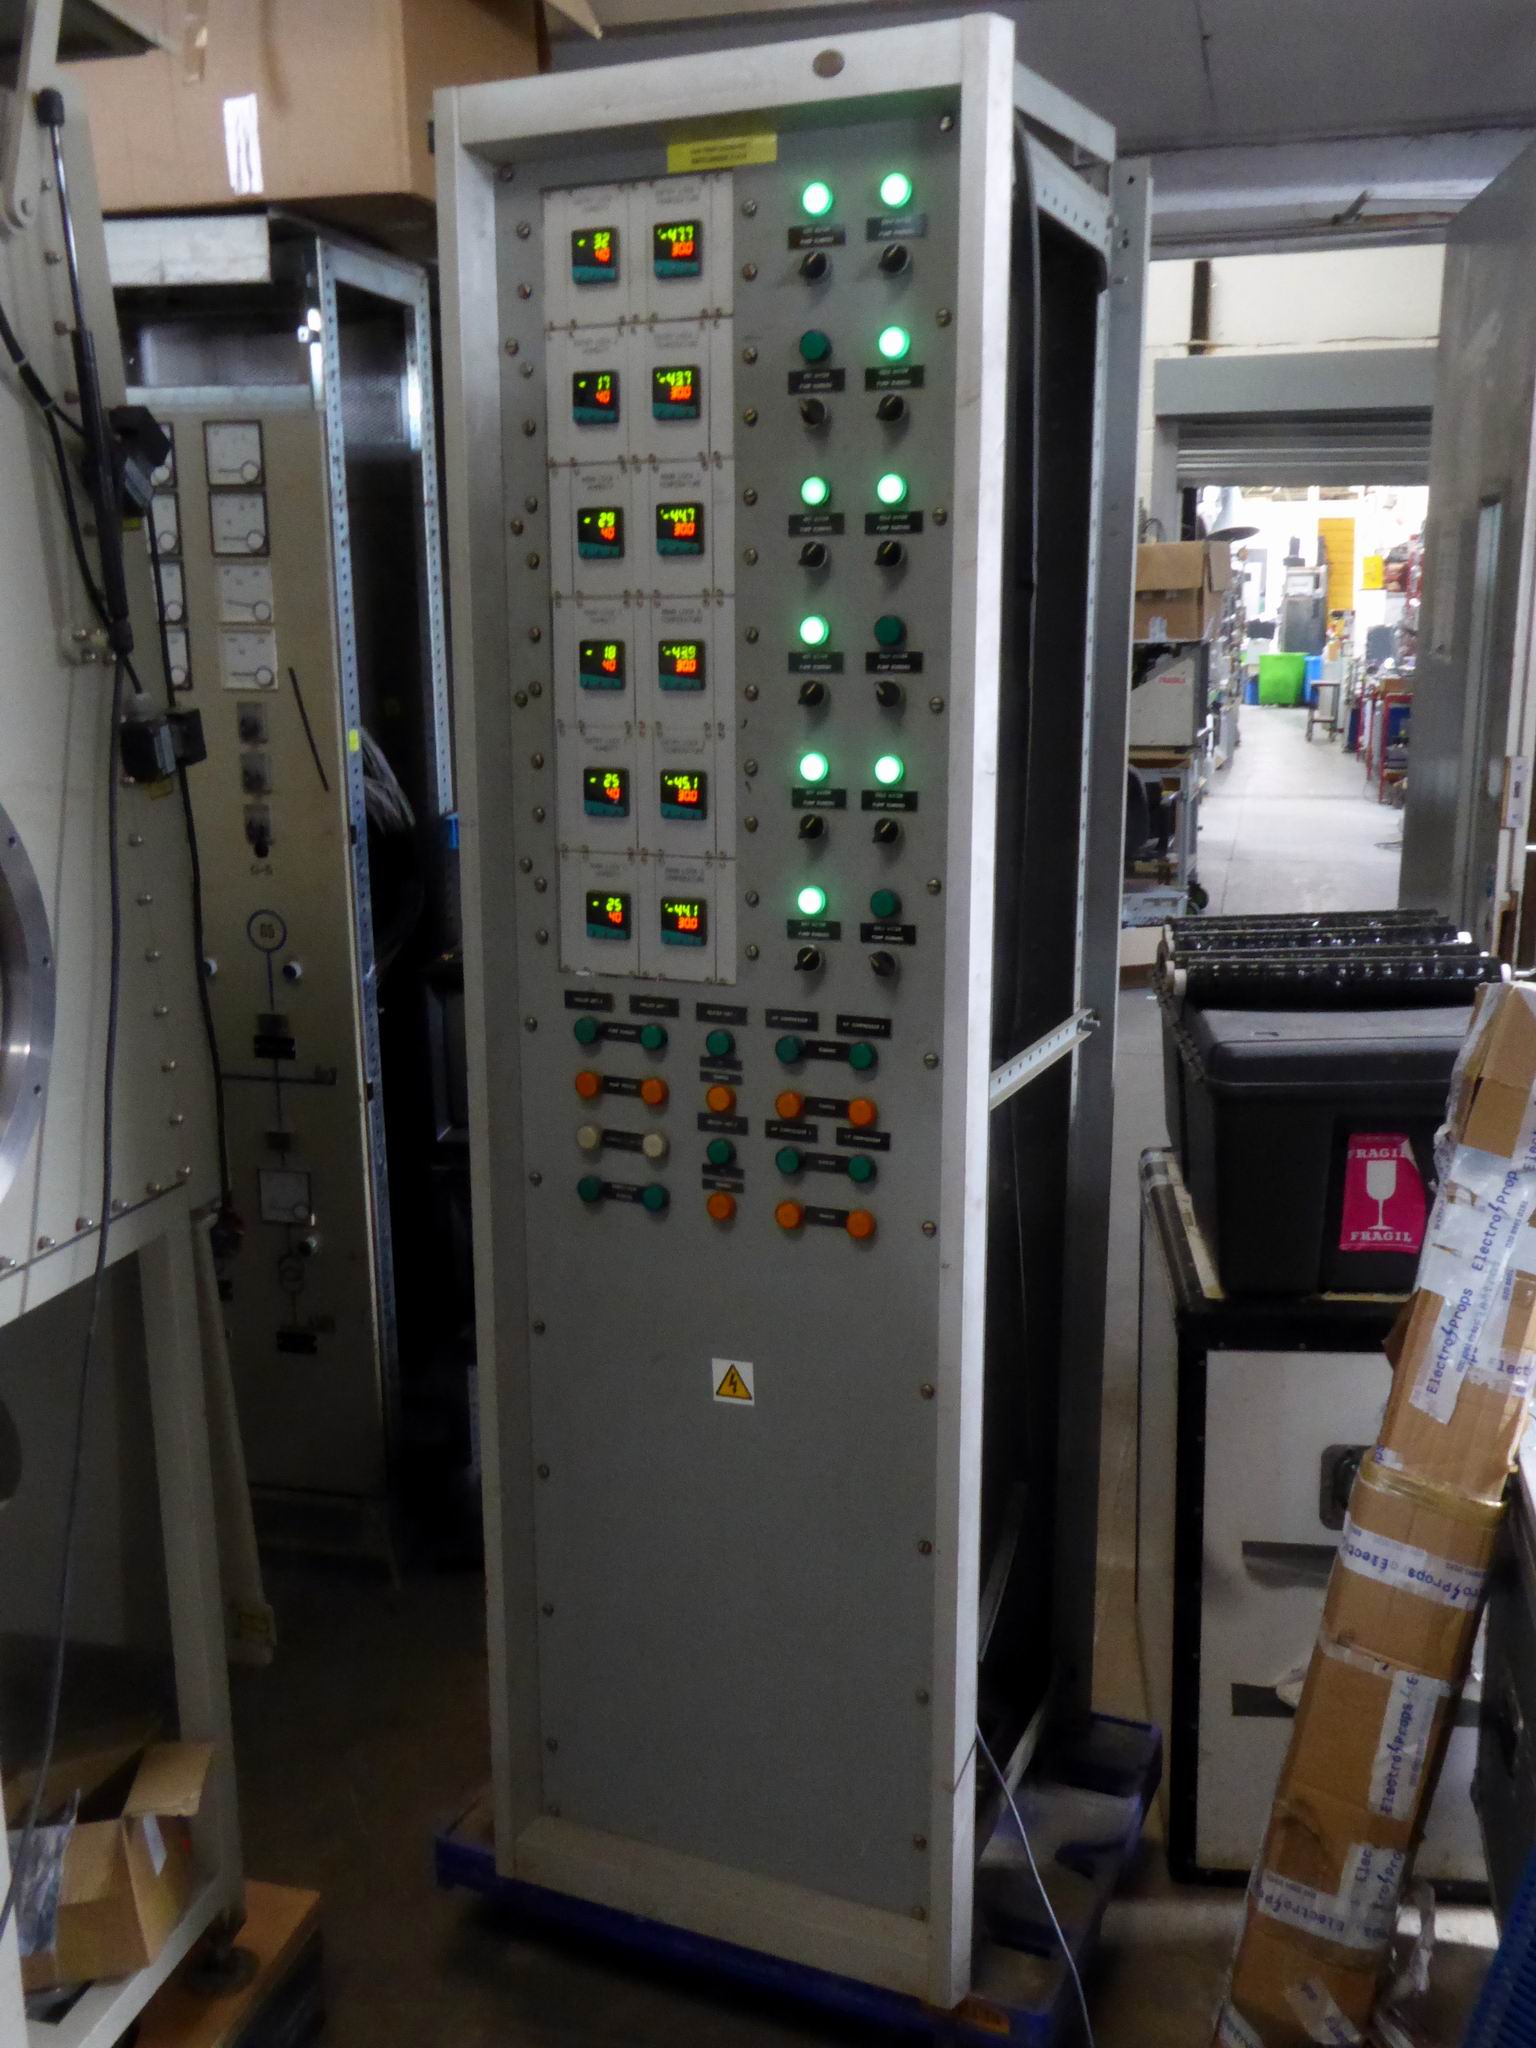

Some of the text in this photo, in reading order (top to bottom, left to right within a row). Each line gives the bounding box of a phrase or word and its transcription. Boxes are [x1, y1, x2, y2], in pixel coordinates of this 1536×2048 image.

[601, 527, 615, 540] 40
[602, 660, 616, 672] 40
[606, 787, 620, 800] 40
[608, 911, 622, 923] 40
[1350, 1231, 1412, 1243] FRAGIL
